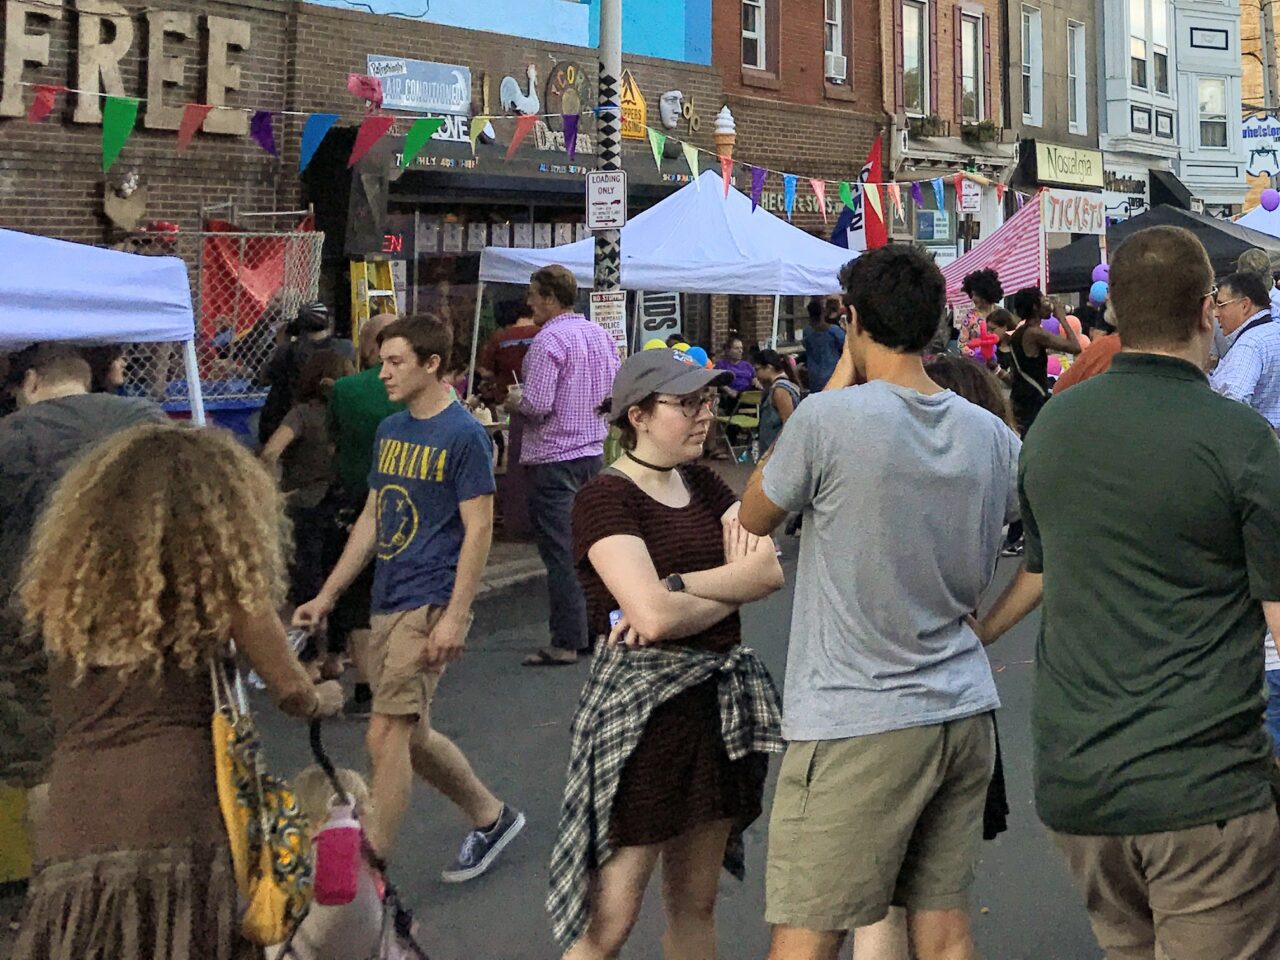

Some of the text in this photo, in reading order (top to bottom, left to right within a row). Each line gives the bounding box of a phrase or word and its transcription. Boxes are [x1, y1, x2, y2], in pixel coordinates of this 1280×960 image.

[384, 78, 402, 100] AIR
[592, 174, 621, 184] LOADING
[1046, 146, 1093, 183] Nostalgia
[597, 186, 615, 195] ONLY
[1049, 194, 1104, 233] TICKETS
[377, 438, 448, 482] NIRVANA
